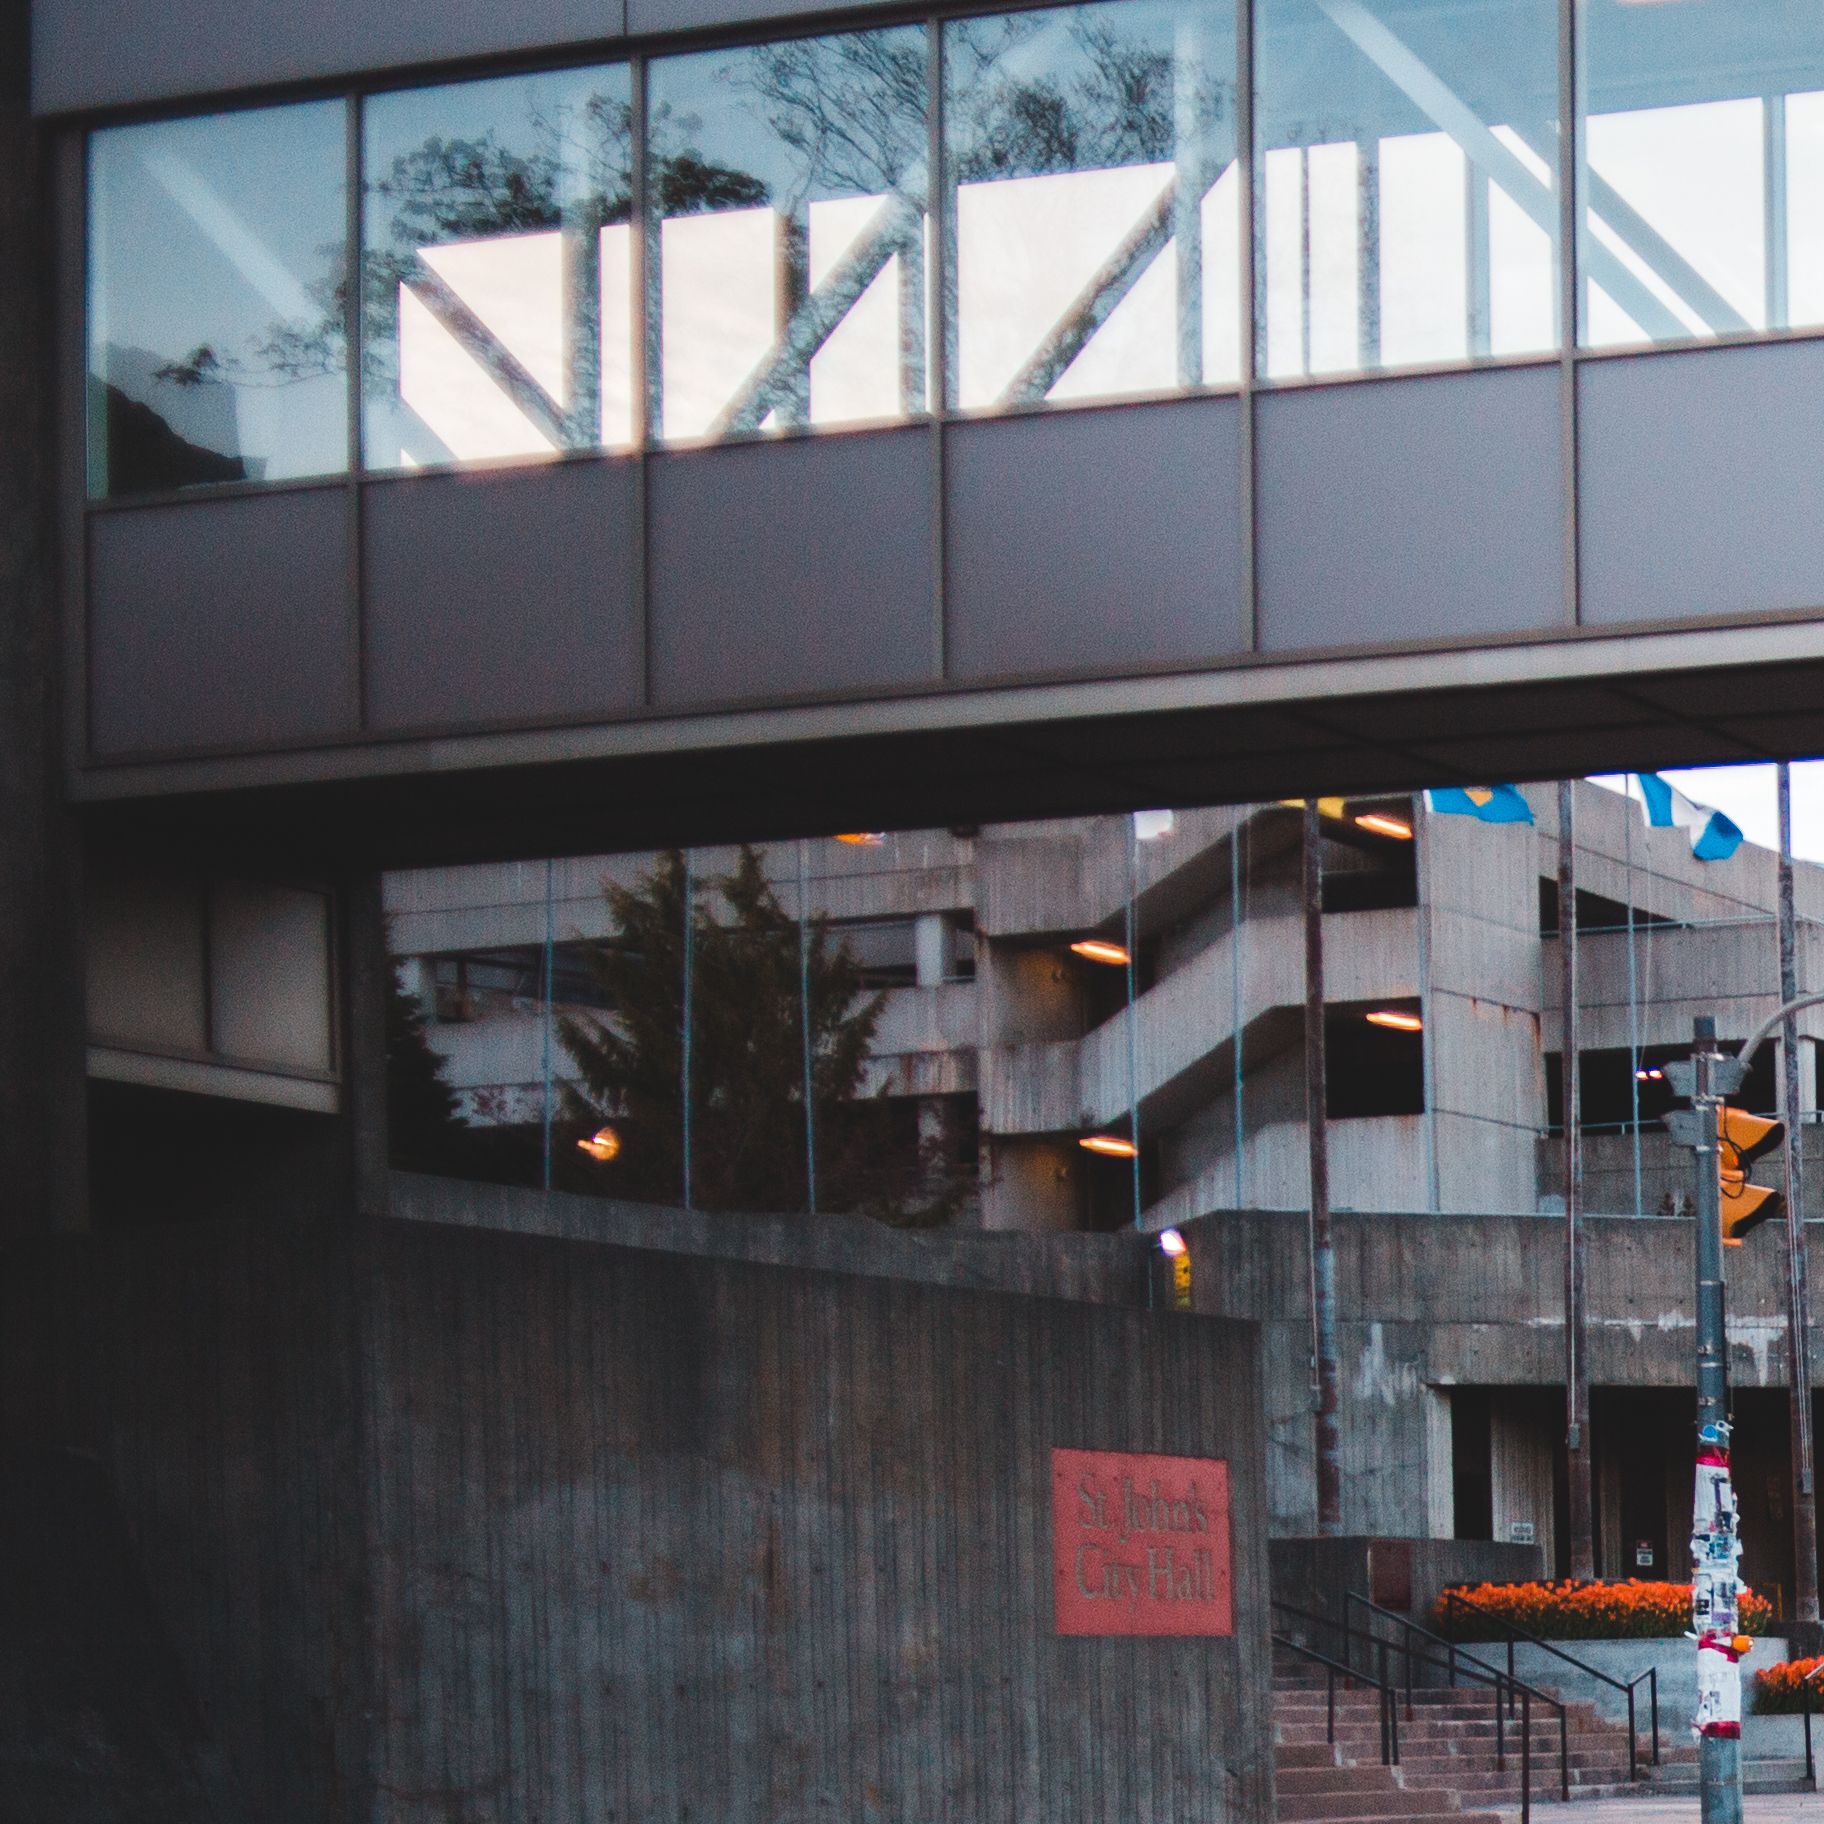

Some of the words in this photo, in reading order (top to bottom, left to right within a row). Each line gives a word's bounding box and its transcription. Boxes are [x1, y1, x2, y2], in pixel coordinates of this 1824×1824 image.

[1118, 1476, 1208, 1541] John's
[1075, 1542, 1141, 1614] City
[1147, 1546, 1213, 1601] Hall
